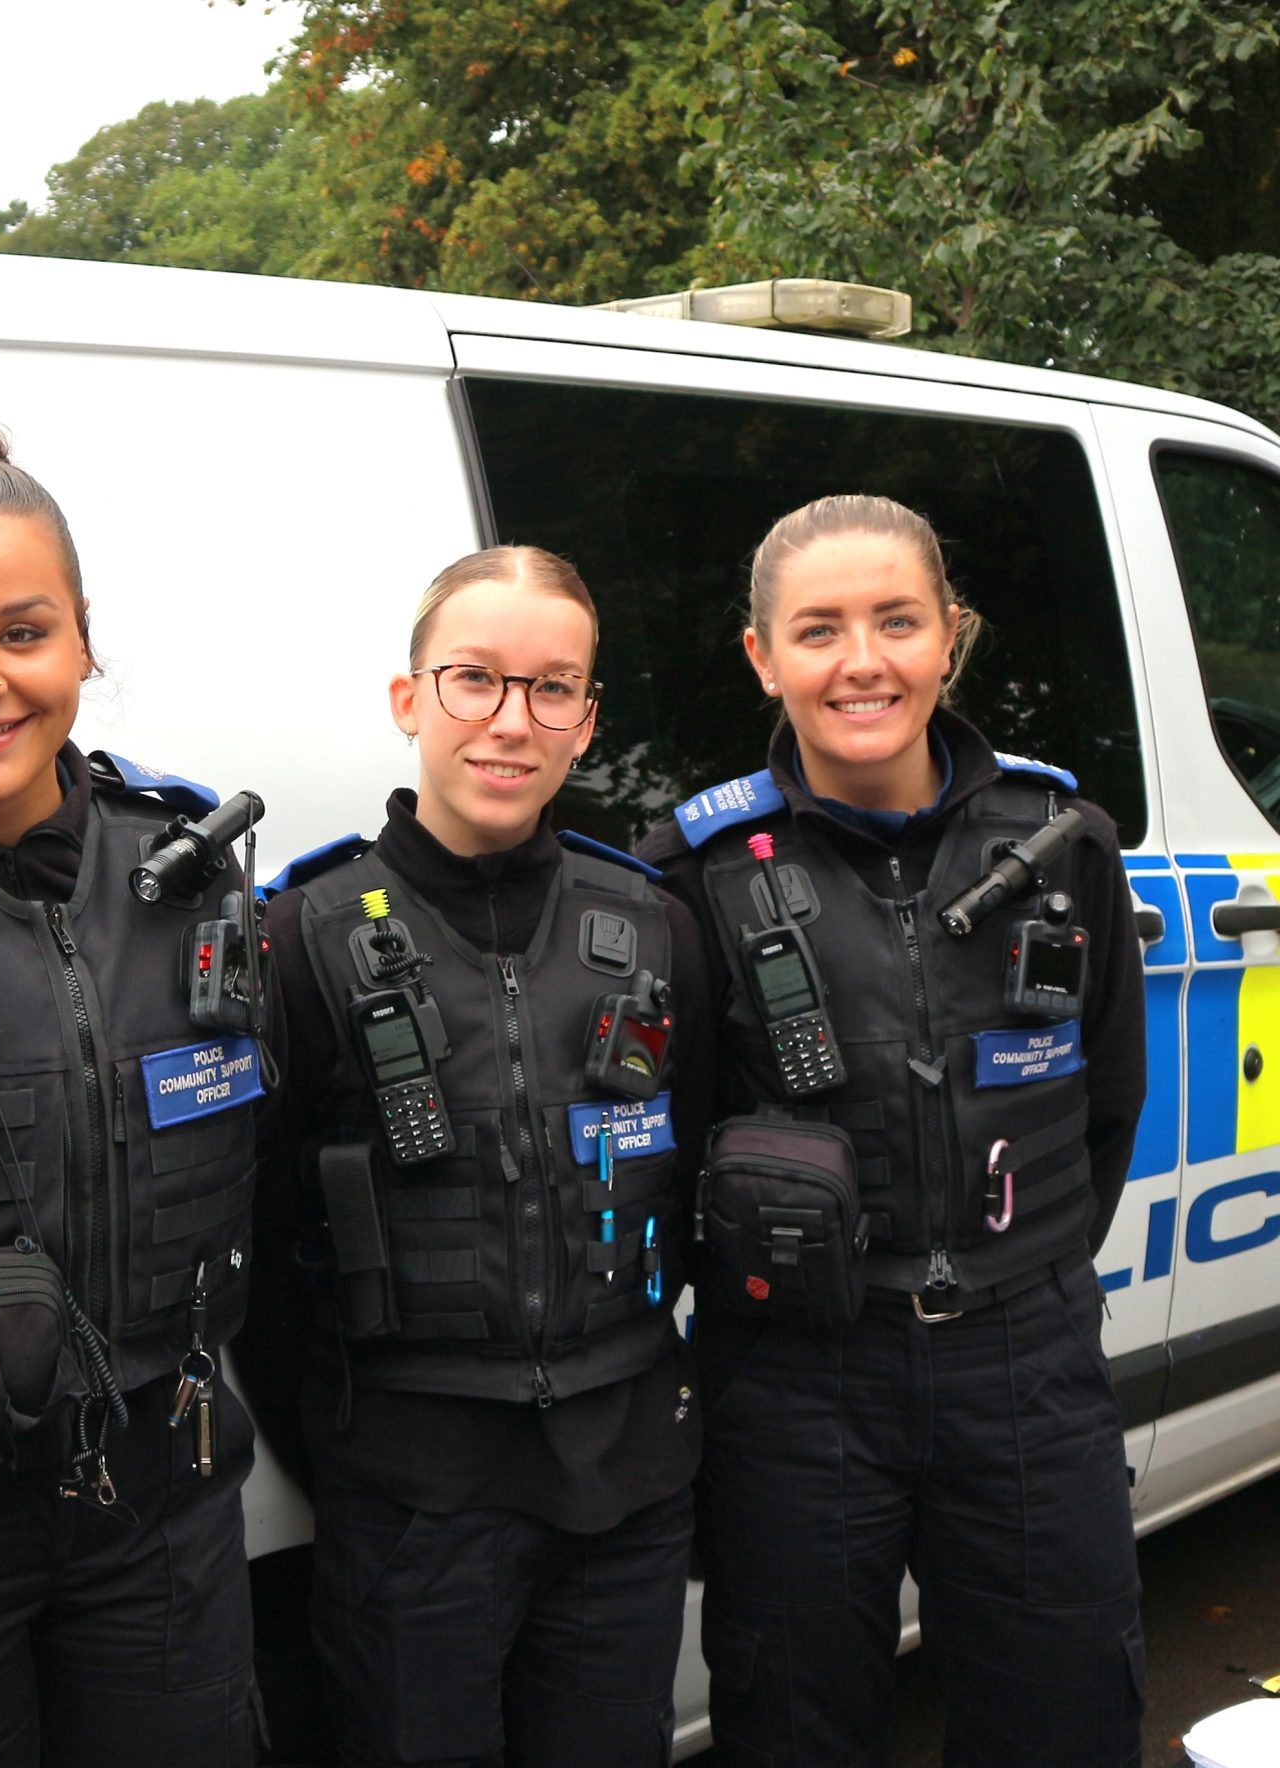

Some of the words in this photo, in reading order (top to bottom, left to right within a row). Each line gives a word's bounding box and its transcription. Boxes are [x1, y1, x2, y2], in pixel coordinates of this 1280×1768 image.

[992, 1050, 1045, 1065] COMMUNITY
[1044, 1042, 1074, 1061] SUPPORT
[1027, 1035, 1055, 1050] POLICE
[193, 1046, 225, 1068] POLICE
[159, 1067, 218, 1095] COMMUNITY
[220, 1054, 253, 1079] SUPPORT
[1021, 1061, 1050, 1077] OFFICER
[196, 1081, 231, 1104] OFFICER
[613, 1102, 646, 1118] POLICE
[583, 1119, 638, 1138] COUNITY
[641, 1113, 667, 1130] SUPPORT
[618, 1133, 652, 1150] OFFICER
